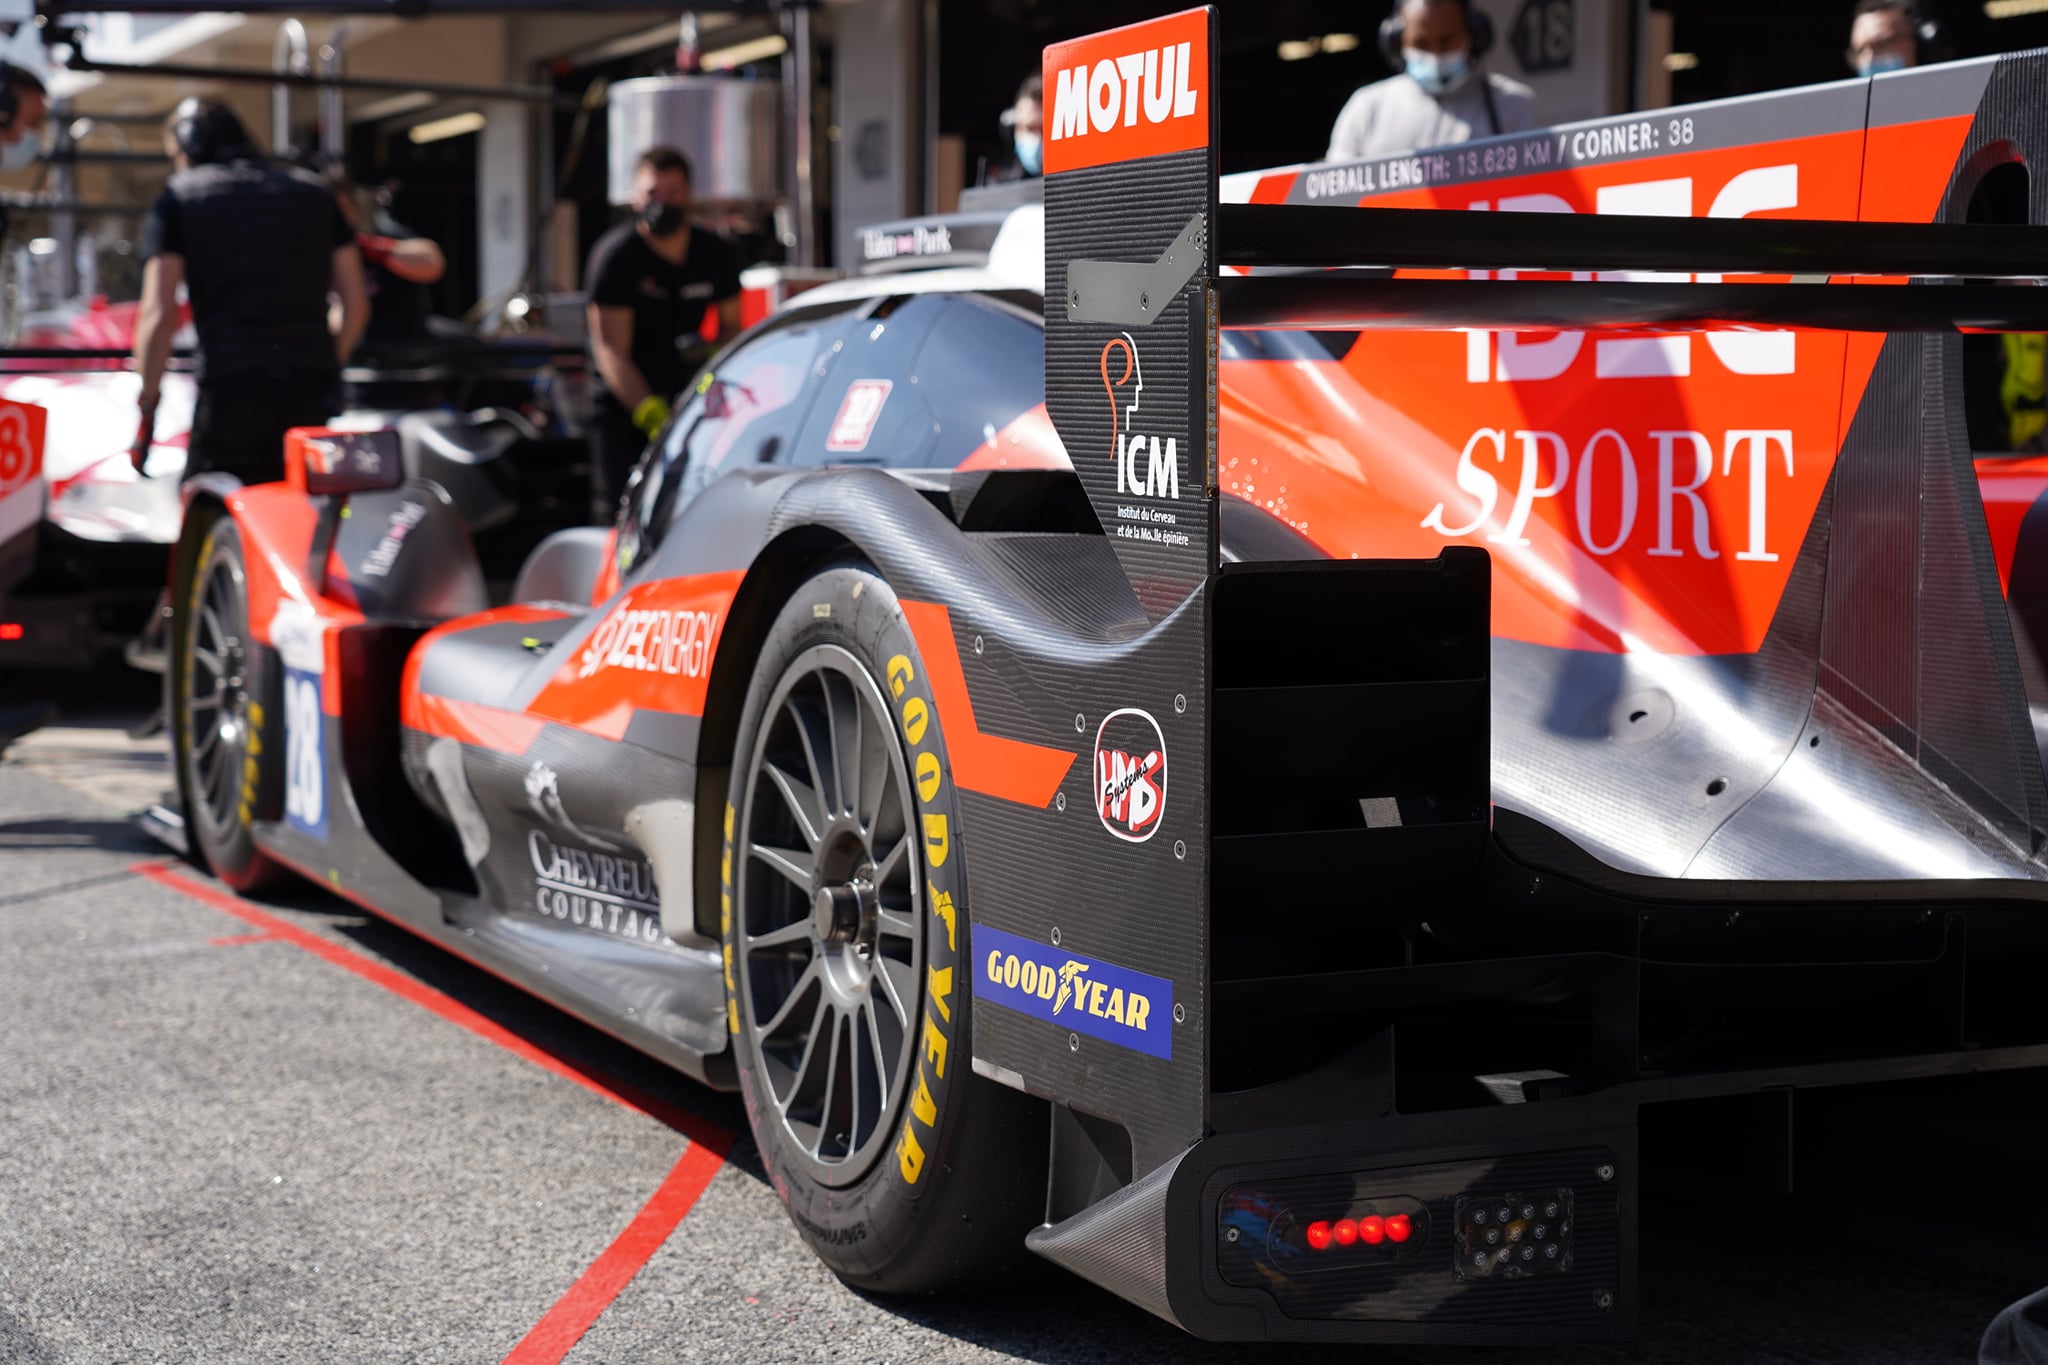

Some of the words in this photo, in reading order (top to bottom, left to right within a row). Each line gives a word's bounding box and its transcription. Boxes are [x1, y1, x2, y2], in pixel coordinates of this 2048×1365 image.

[1051, 41, 1198, 141] MOTUL
[1306, 166, 1375, 198] OVERALL
[1380, 155, 1450, 187] LENGTH:
[1457, 146, 1517, 177] 13.629
[1524, 141, 1551, 167] KM
[1572, 122, 1659, 160] CORNER:
[1668, 118, 1694, 146] 38
[1117, 433, 1179, 499] ICM
[1420, 427, 1794, 562] SPORT
[1117, 505, 1140, 521] Institut
[1141, 507, 1149, 521] du
[1150, 509, 1175, 524] Cerveau
[1117, 525, 1124, 537] et
[1125, 525, 1133, 539] de
[1134, 526, 1139, 540] la
[1105, 762, 1149, 806] Systems
[536, 887, 676, 946] COURTAG
[987, 950, 1056, 1000] GOOD
[1073, 976, 1150, 1031] YEAR
